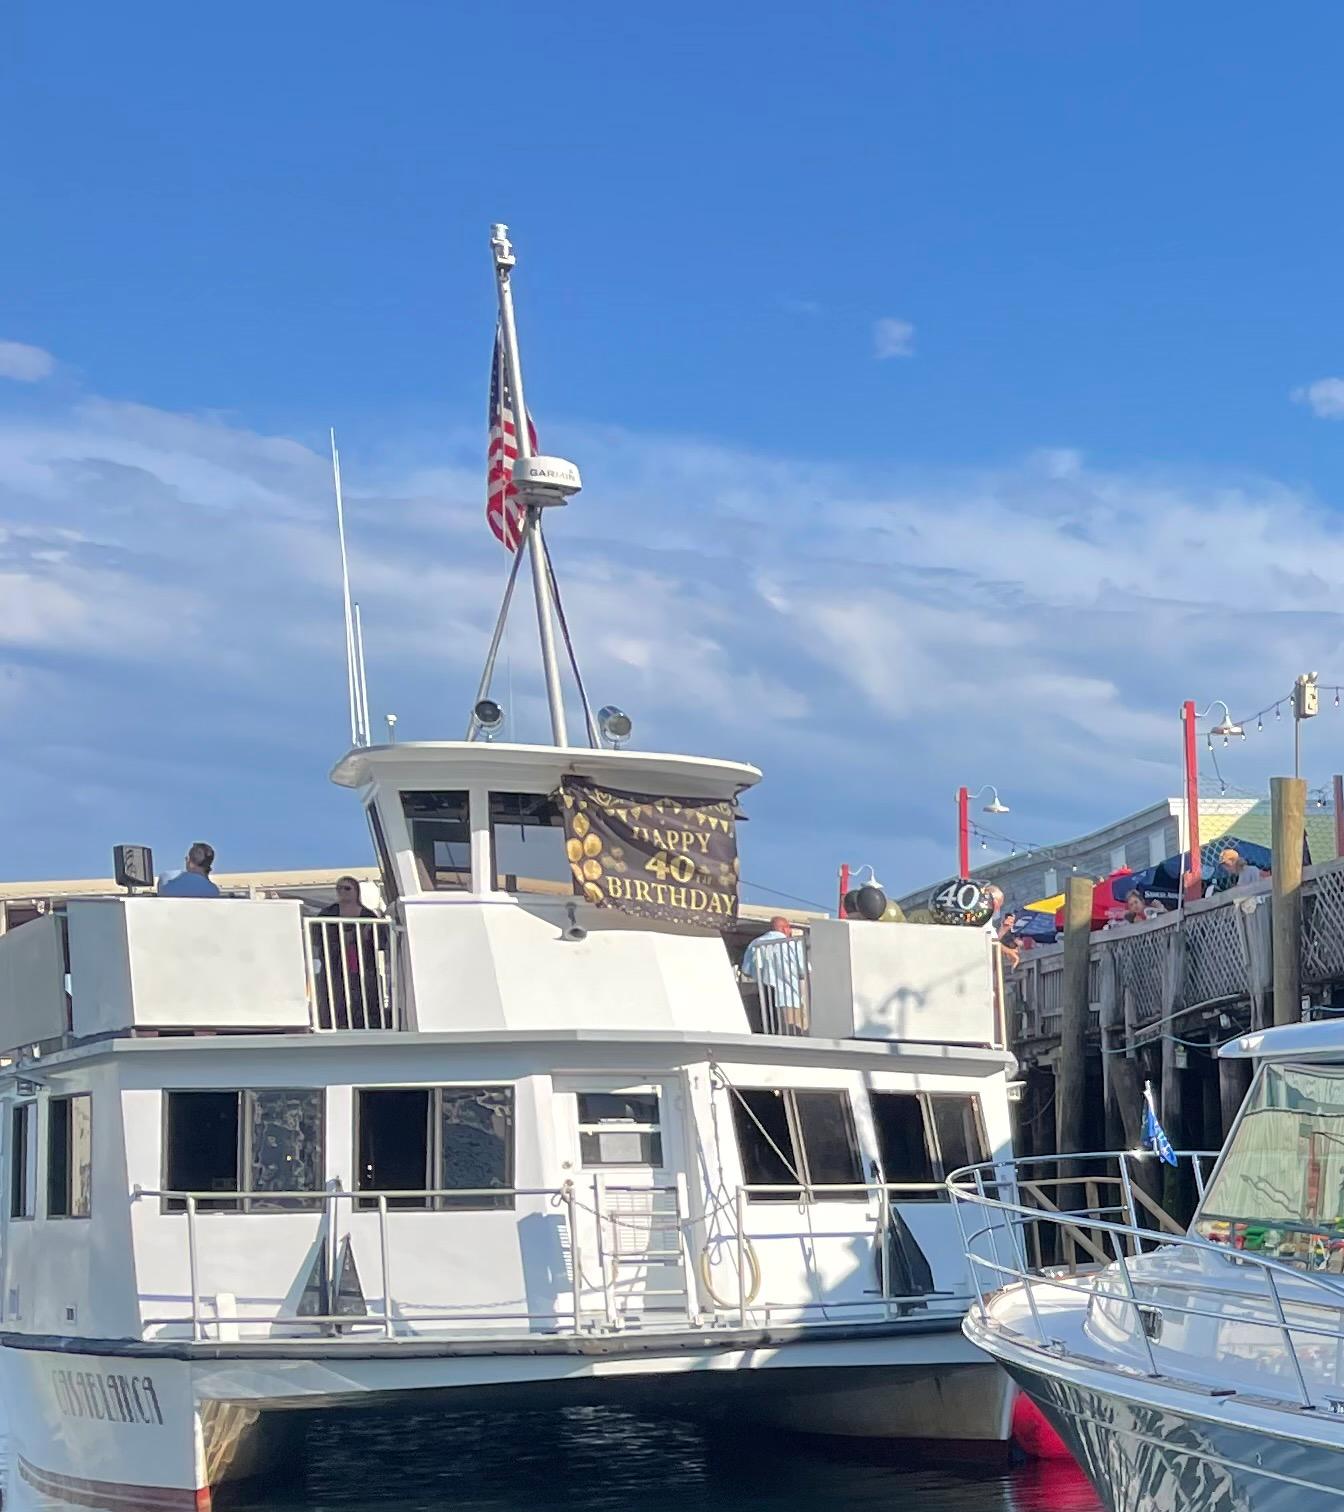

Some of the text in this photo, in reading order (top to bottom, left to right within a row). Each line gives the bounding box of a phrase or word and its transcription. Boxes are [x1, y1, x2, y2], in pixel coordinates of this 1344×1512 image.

[632, 827, 711, 853] HAPPY
[606, 875, 736, 915] BIRTHDAY
[936, 882, 980, 910] 40
